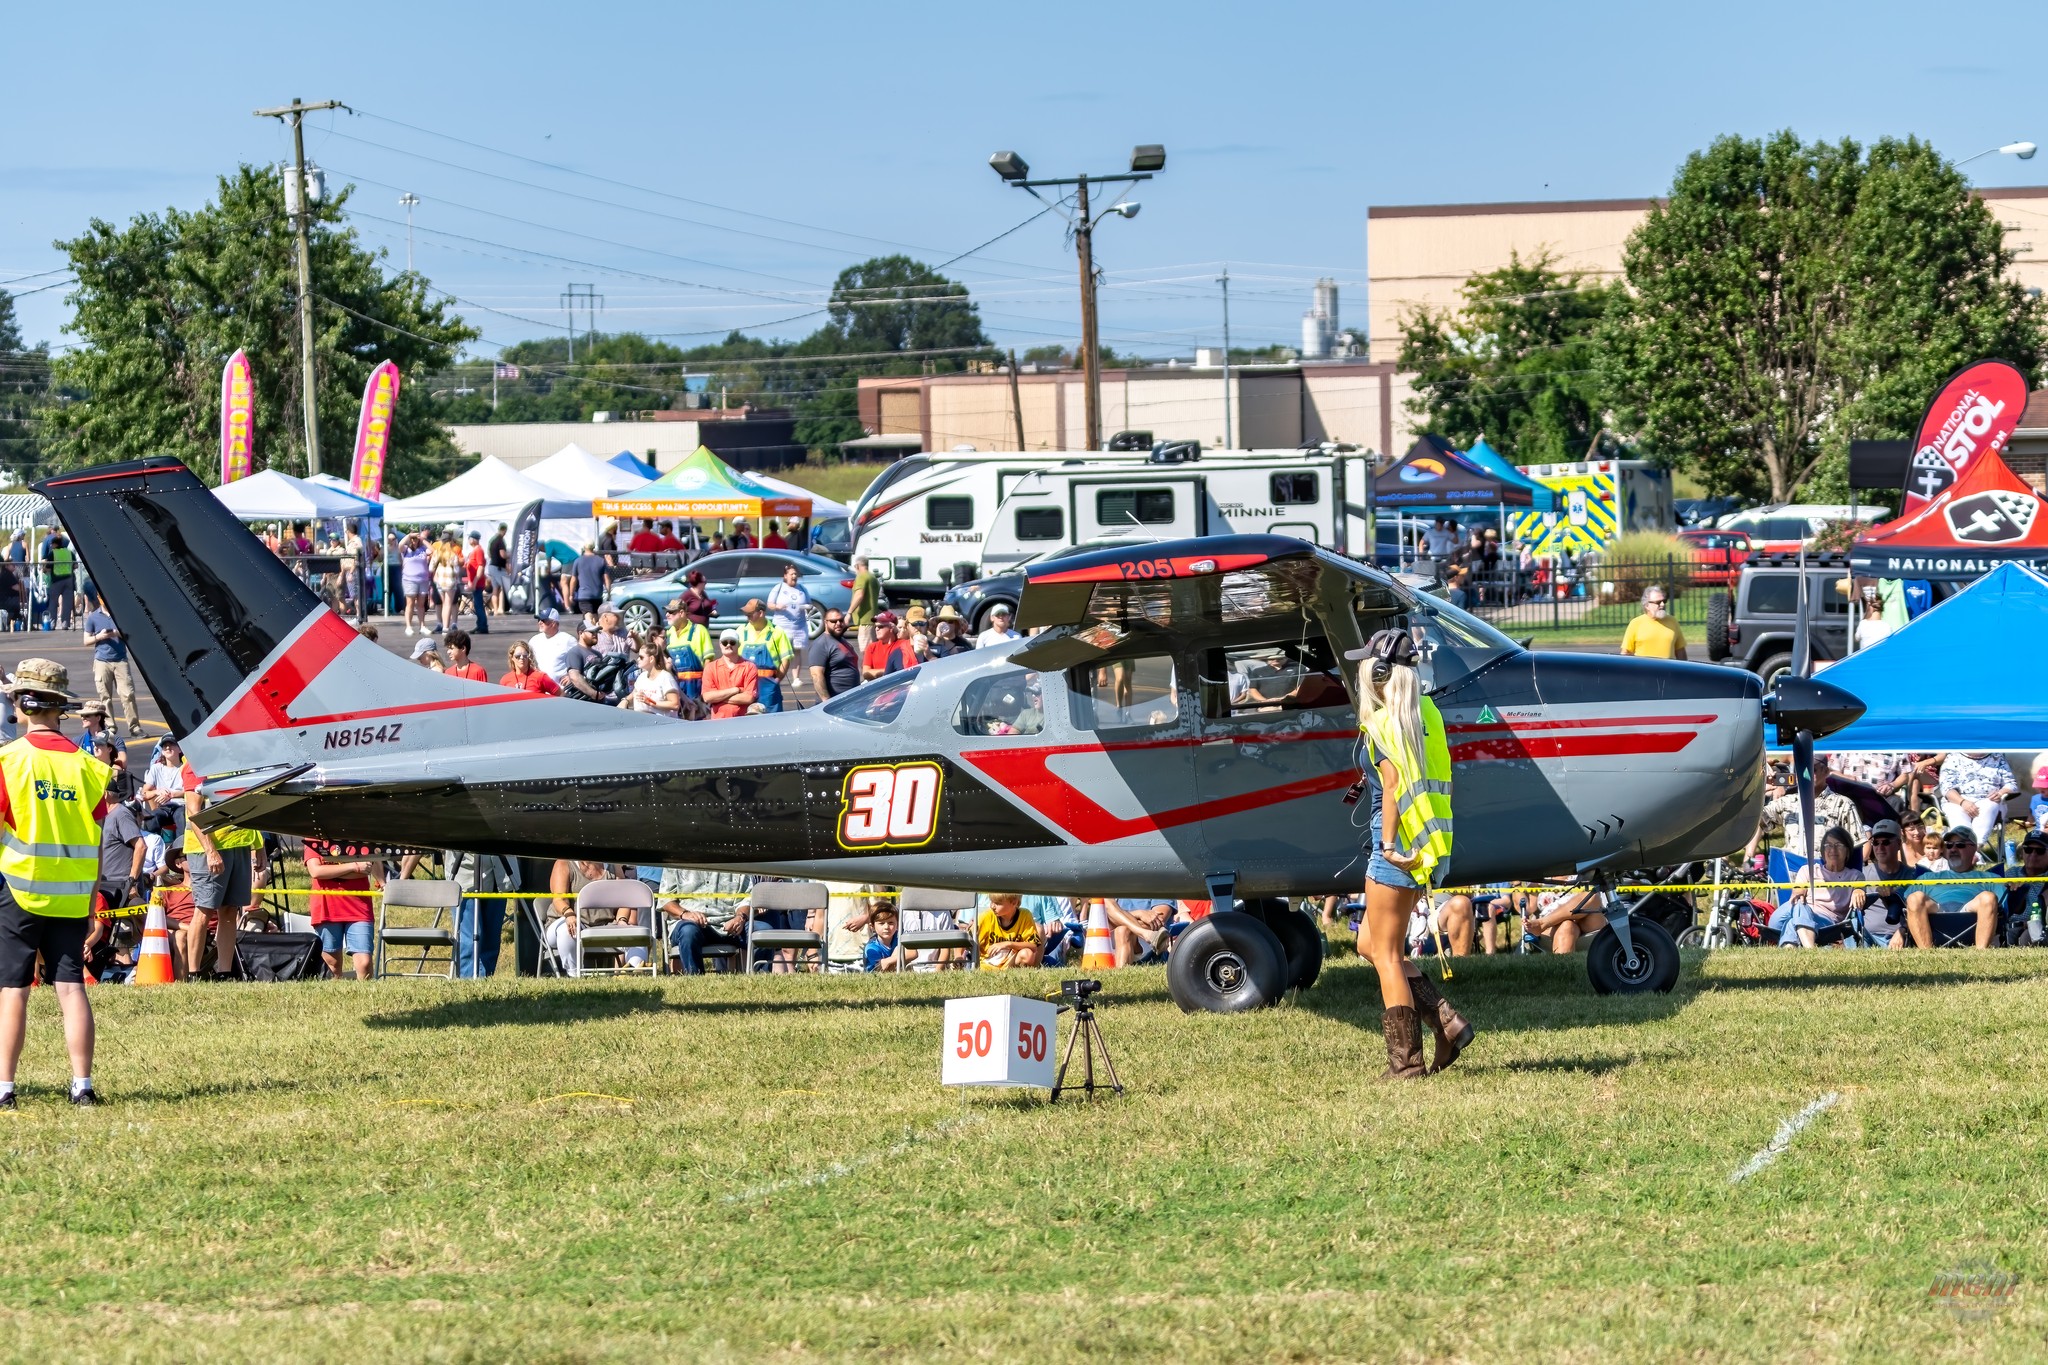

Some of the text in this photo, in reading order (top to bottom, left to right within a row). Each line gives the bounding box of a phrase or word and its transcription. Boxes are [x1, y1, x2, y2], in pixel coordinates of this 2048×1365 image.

[1933, 389, 1980, 450] NATIONAL
[1943, 395, 2006, 469] STOL
[602, 502, 619, 510] TRUE
[656, 502, 690, 510] AMAZING
[1218, 507, 1286, 518] MINNIE
[522, 529, 532, 564] AVIATION
[920, 532, 983, 543] North Trail
[1121, 559, 1173, 579] 205
[1888, 558, 2048, 572] NATIONALSL.
[324, 723, 403, 749] N8154Z
[843, 765, 939, 842] 30
[956, 1019, 992, 1059] 50
[1017, 1021, 1047, 1062] 50
